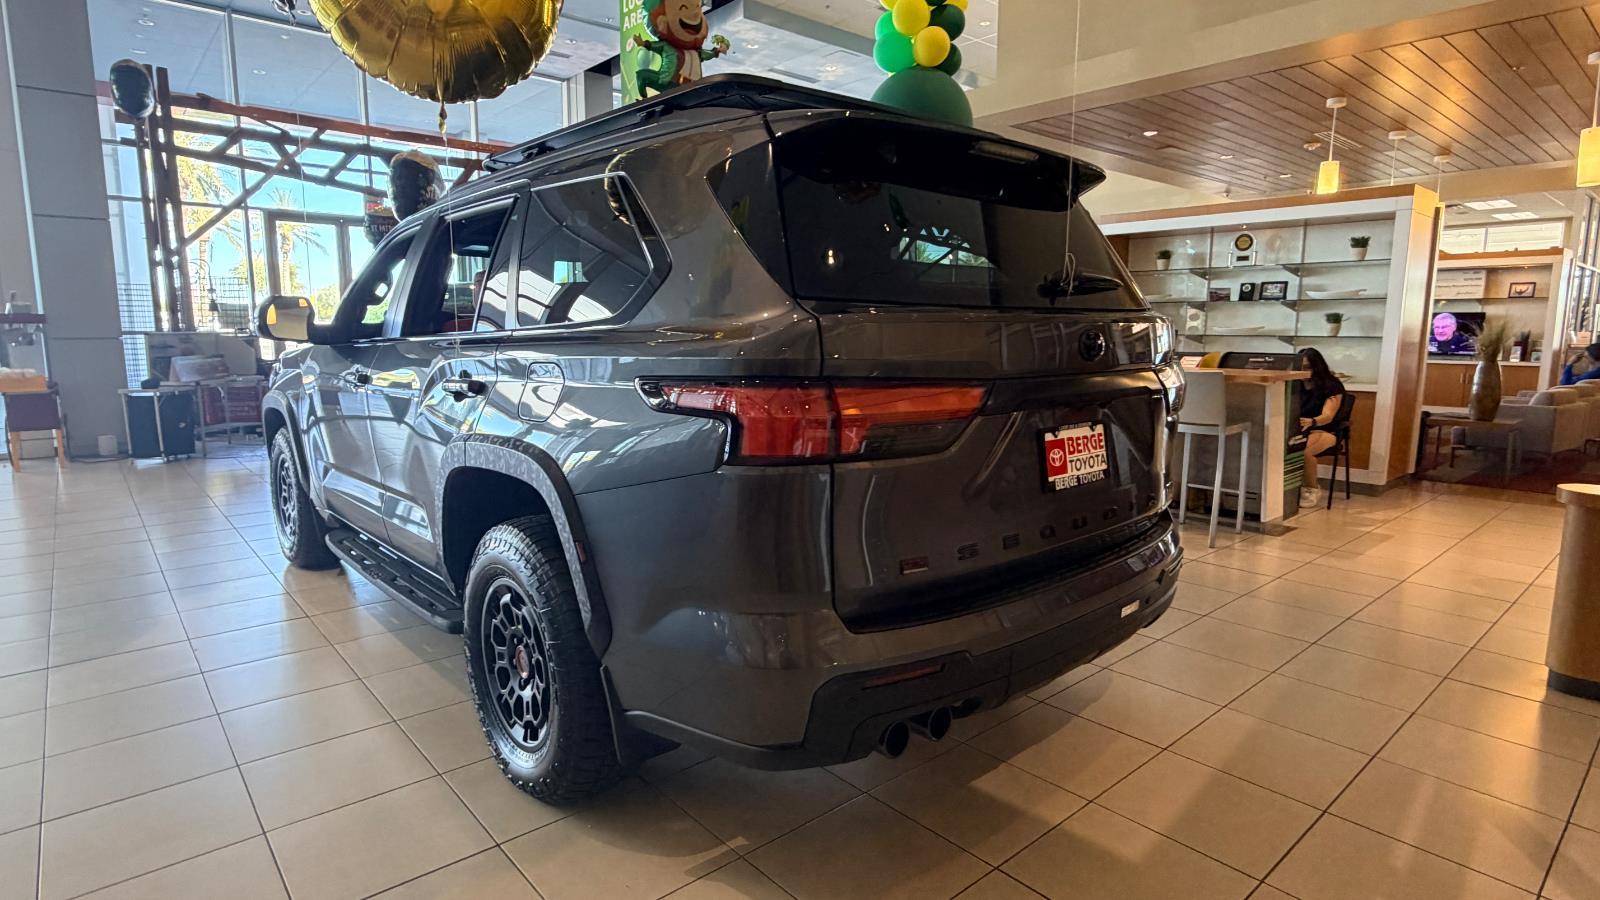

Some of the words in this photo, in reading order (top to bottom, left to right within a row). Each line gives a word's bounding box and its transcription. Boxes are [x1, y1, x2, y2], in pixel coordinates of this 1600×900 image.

[1066, 432, 1104, 456] BERGE
[1068, 454, 1107, 473] TOYOTA
[1055, 477, 1078, 491] BERGE
[1079, 470, 1105, 485] TOYOTA
